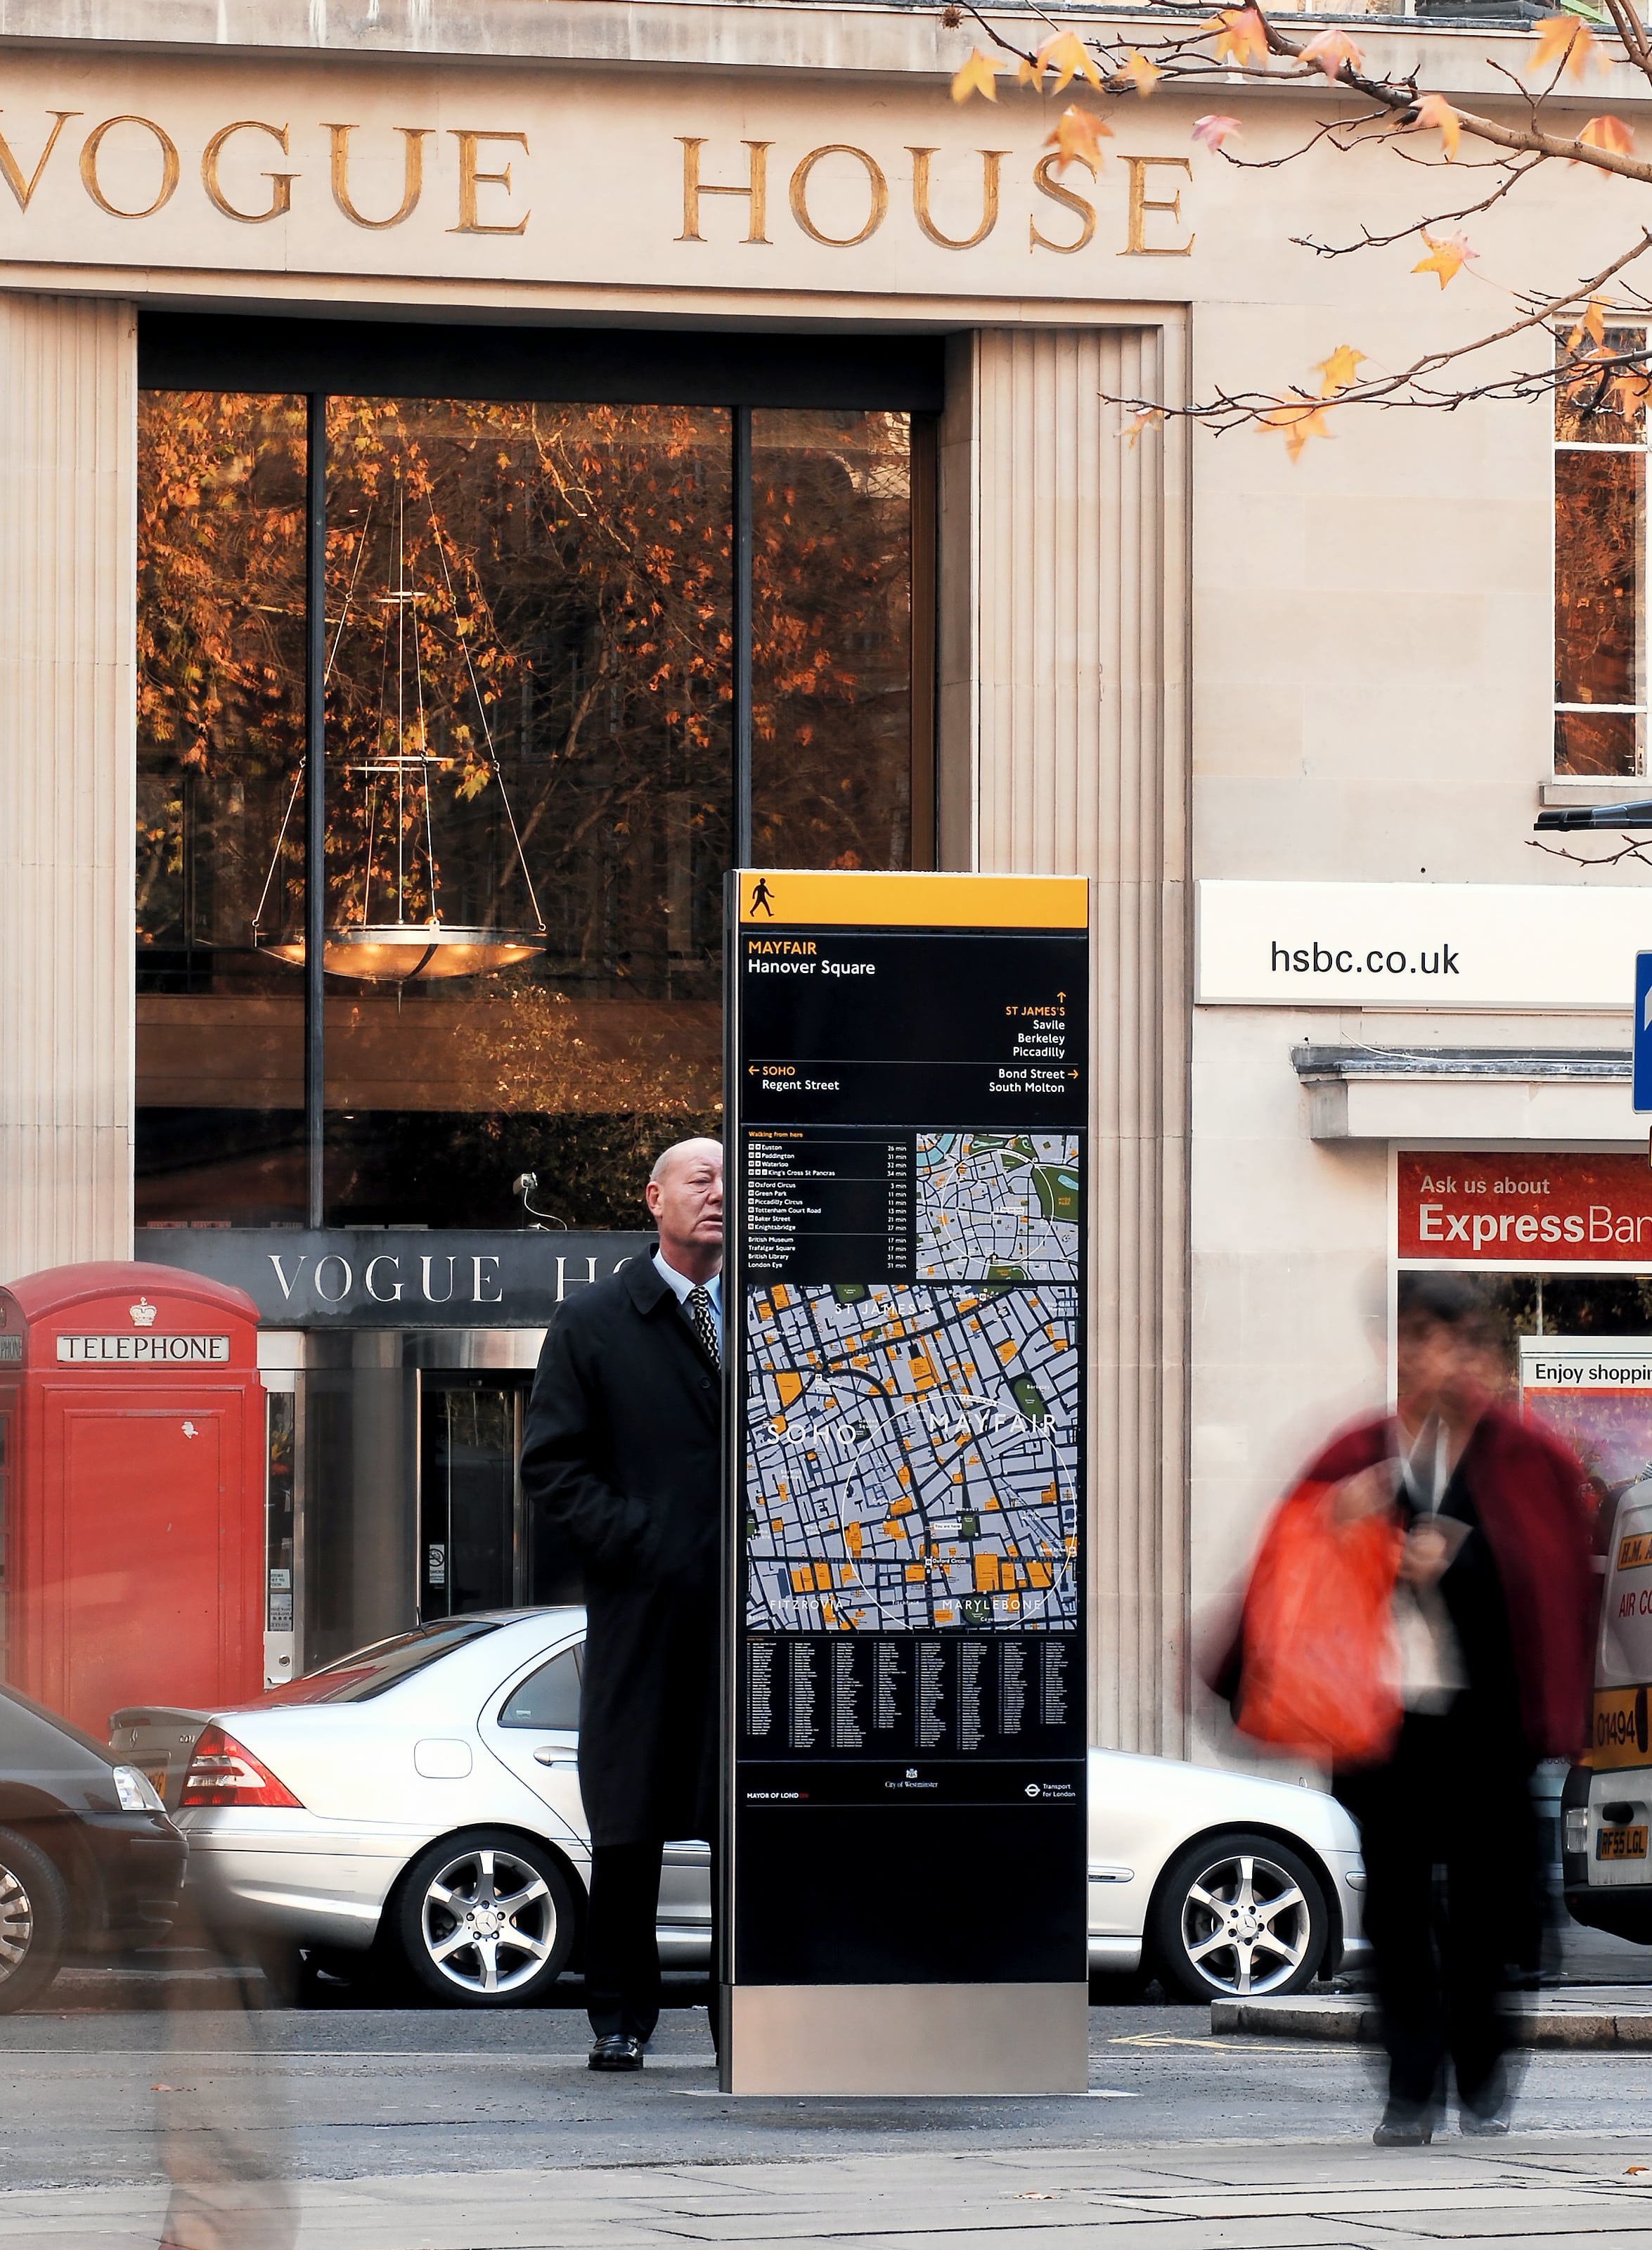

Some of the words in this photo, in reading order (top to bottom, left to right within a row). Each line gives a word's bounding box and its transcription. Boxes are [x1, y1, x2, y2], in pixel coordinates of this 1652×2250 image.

[0, 110, 532, 236] VOGUE
[673, 137, 1196, 257] HOUSE
[748, 941, 817, 955] MAYFAIR
[1272, 941, 1459, 974] hsbc.co.uk
[748, 959, 816, 974] Hanover
[821, 960, 875, 977] Square
[1005, 1006, 1018, 1015] ST
[1021, 1006, 1066, 1016] JAMES'S
[1033, 1020, 1065, 1030] Savile
[1018, 1033, 1065, 1046] Berkeley
[1013, 1046, 1065, 1059] Piccadilly
[762, 1066, 796, 1076] SOHO
[998, 1068, 1027, 1079] Bond
[1031, 1069, 1065, 1079] Street
[762, 1079, 802, 1092] Regent
[805, 1080, 840, 1091] Street
[989, 1082, 1021, 1092] South
[1025, 1083, 1064, 1093] Molton
[1420, 1175, 1457, 1193] Ask
[1464, 1179, 1487, 1194] us
[1493, 1176, 1550, 1194] about
[267, 1255, 503, 1303] VOGUE
[835, 1303, 853, 1314] ST
[63, 1337, 222, 1359] TELEPHONE
[1535, 1363, 1584, 1383] Enjoy
[929, 1413, 1056, 1433] MAYFAIR
[767, 1424, 857, 1445] SOHO
[770, 1600, 844, 1609] FITZROVIA
[942, 1600, 1041, 1610] MARYLEBONE
[1619, 1592, 1636, 1618] AIR
[1597, 1710, 1635, 1747] 01494
[1602, 1831, 1625, 1855] RF55
[1627, 1830, 1644, 1854] LGL
